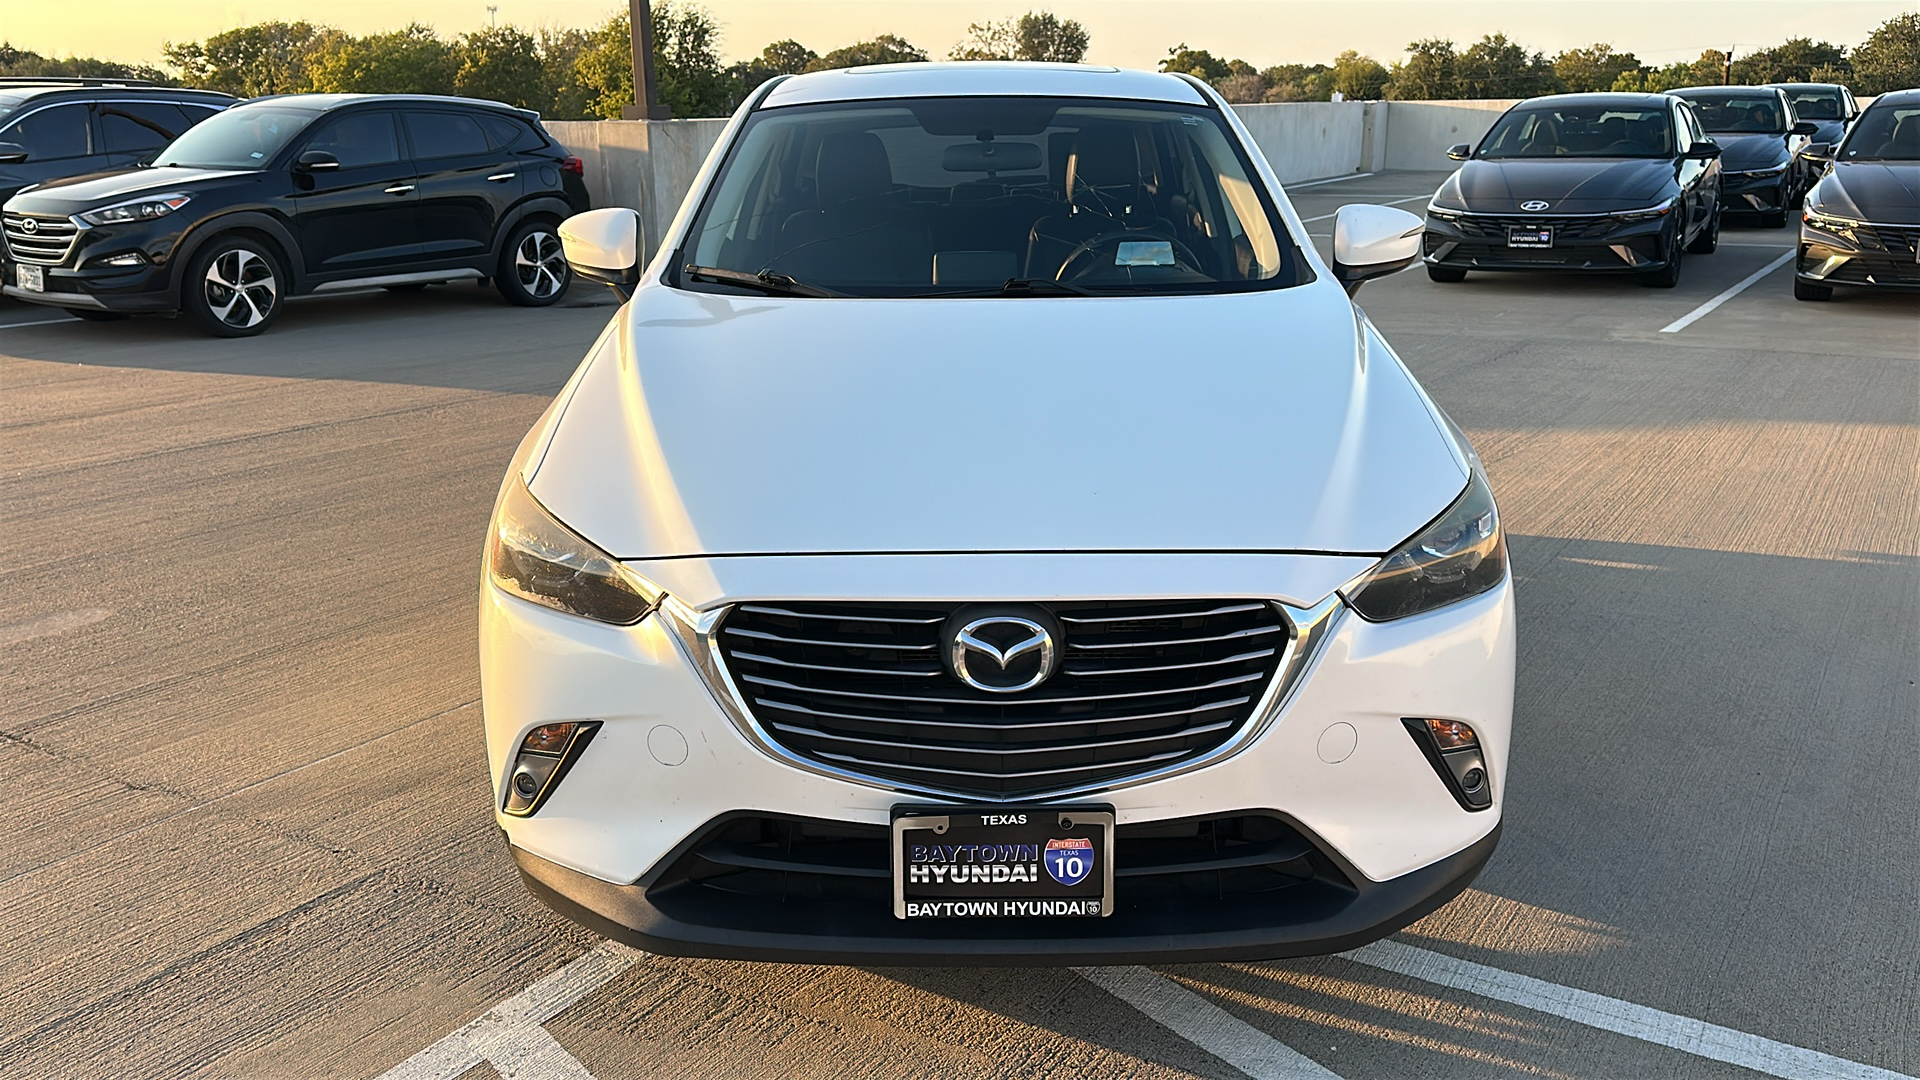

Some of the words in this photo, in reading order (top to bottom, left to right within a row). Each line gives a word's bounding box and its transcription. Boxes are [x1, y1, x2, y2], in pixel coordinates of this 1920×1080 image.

[981, 815, 1027, 826] TEXAS
[911, 844, 1038, 863] BAYTOWN
[910, 864, 1038, 883] HYUNDAI
[1055, 857, 1083, 878] 10
[907, 902, 998, 917] BAYTOWN
[1003, 901, 1086, 916] HYUNDAI
